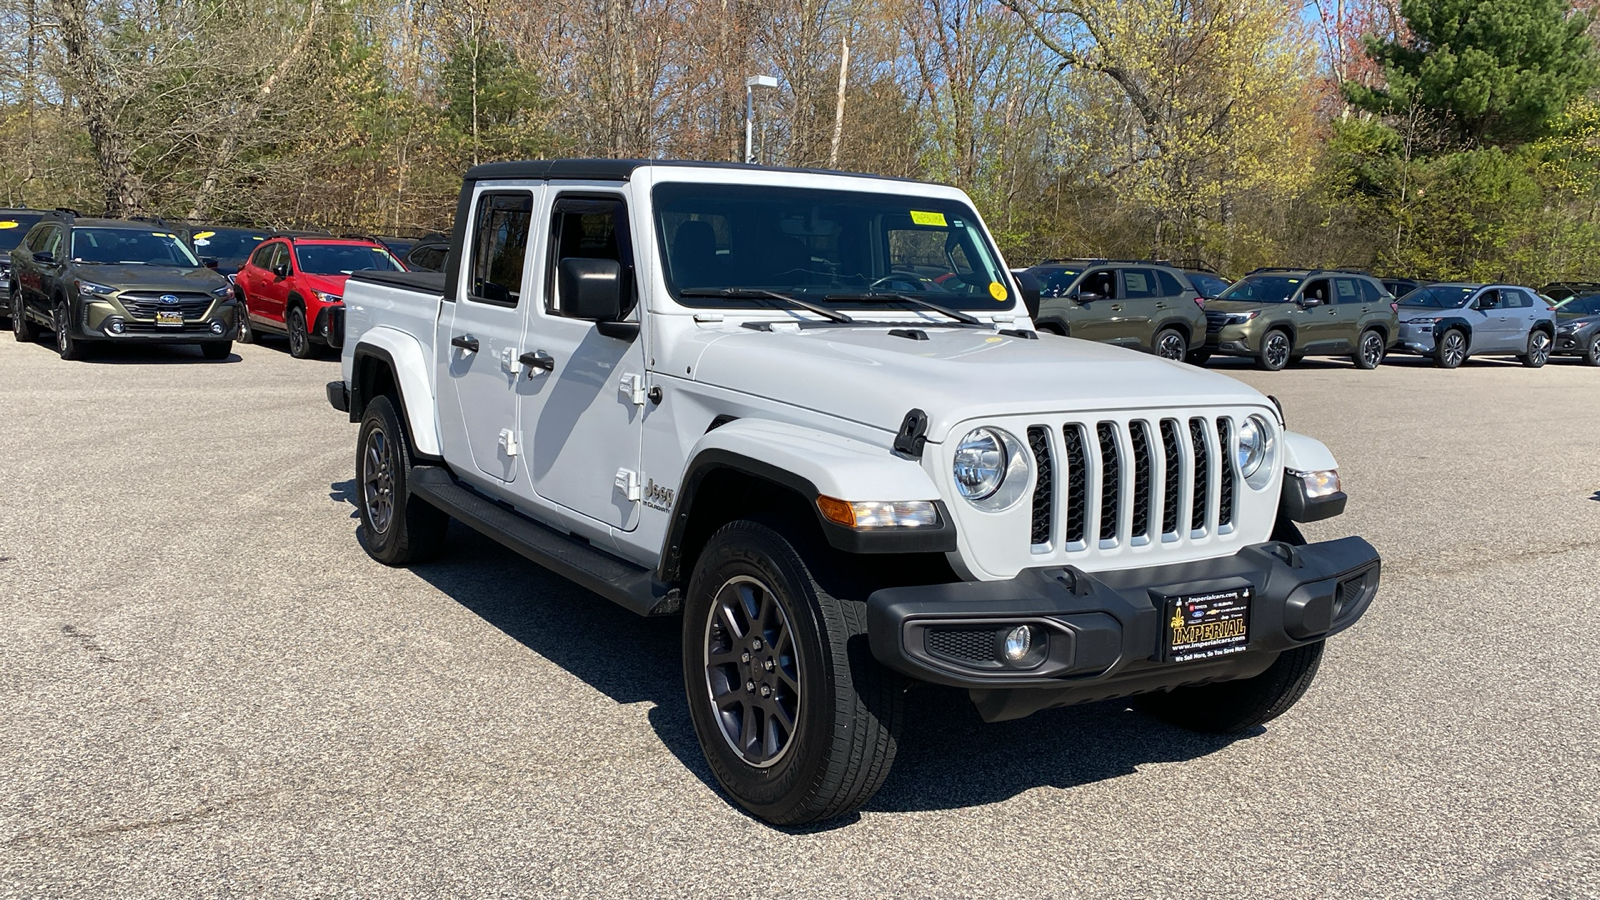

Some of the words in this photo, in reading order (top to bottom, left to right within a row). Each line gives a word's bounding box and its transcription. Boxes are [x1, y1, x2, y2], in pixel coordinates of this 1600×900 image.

[644, 478, 675, 508] Jeep
[1172, 618, 1246, 645] IMPERIAL
[1172, 636, 1246, 651] www.imperialcars.com
